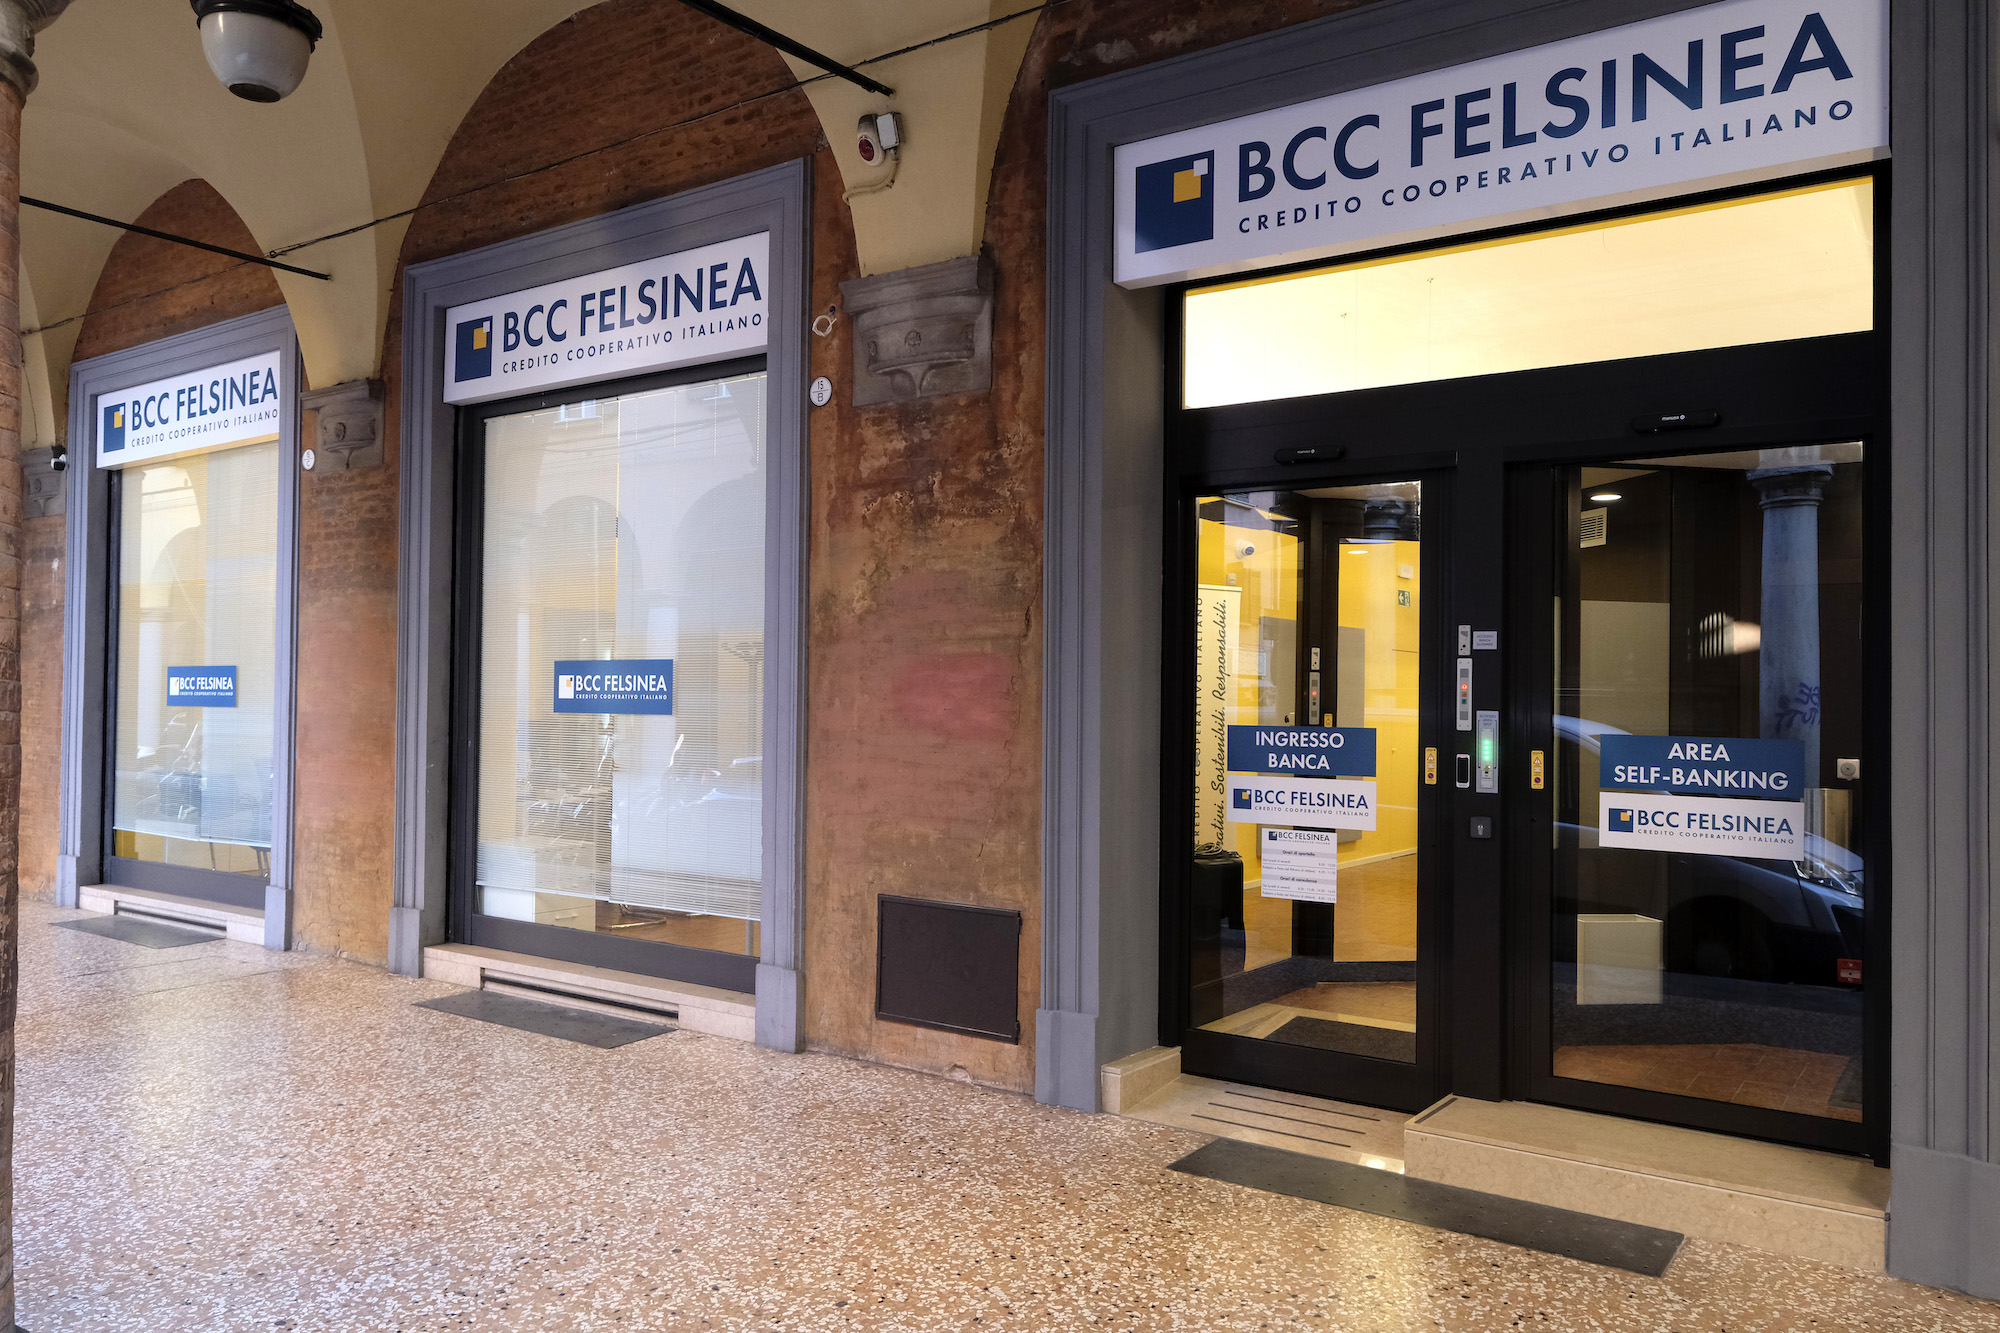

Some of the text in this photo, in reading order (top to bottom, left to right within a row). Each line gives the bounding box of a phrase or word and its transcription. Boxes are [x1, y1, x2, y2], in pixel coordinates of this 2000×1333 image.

[1238, 11, 1854, 204] BCC FELSINEA
[1238, 99, 1854, 235] CREDITO COOPERATIVO ITALIANO
[503, 257, 762, 352] BCC FELSINEA
[502, 313, 763, 374] CREDITO COOPERATIVO ITALIANO
[817, 380, 824, 390] 15
[131, 367, 278, 431] BCC FELSINEA
[817, 392, 824, 402] B
[131, 408, 279, 448] CREDITO COOPERATIVO ITALIANO
[1211, 599, 1231, 701] Responsabili.
[180, 677, 233, 690] BCC FELSINEA
[575, 675, 667, 692] BCC FELSINEA
[1255, 731, 1345, 749] INGRESSO
[1211, 706, 1226, 795] Sostenibili.
[1667, 742, 1731, 762] AREA
[1268, 753, 1331, 770] BANCA
[1613, 765, 1789, 791] SELF-BANKING
[1254, 789, 1369, 809] BCC FELSINEA
[1285, 807, 1333, 815] COOPERATIVO
[1637, 810, 1794, 836] BCC FELSINEA
[1278, 831, 1330, 841] BCC FELSINEA
[1679, 831, 1744, 841] COOPERATIVO
[1749, 836, 1794, 845] ITALIANO
